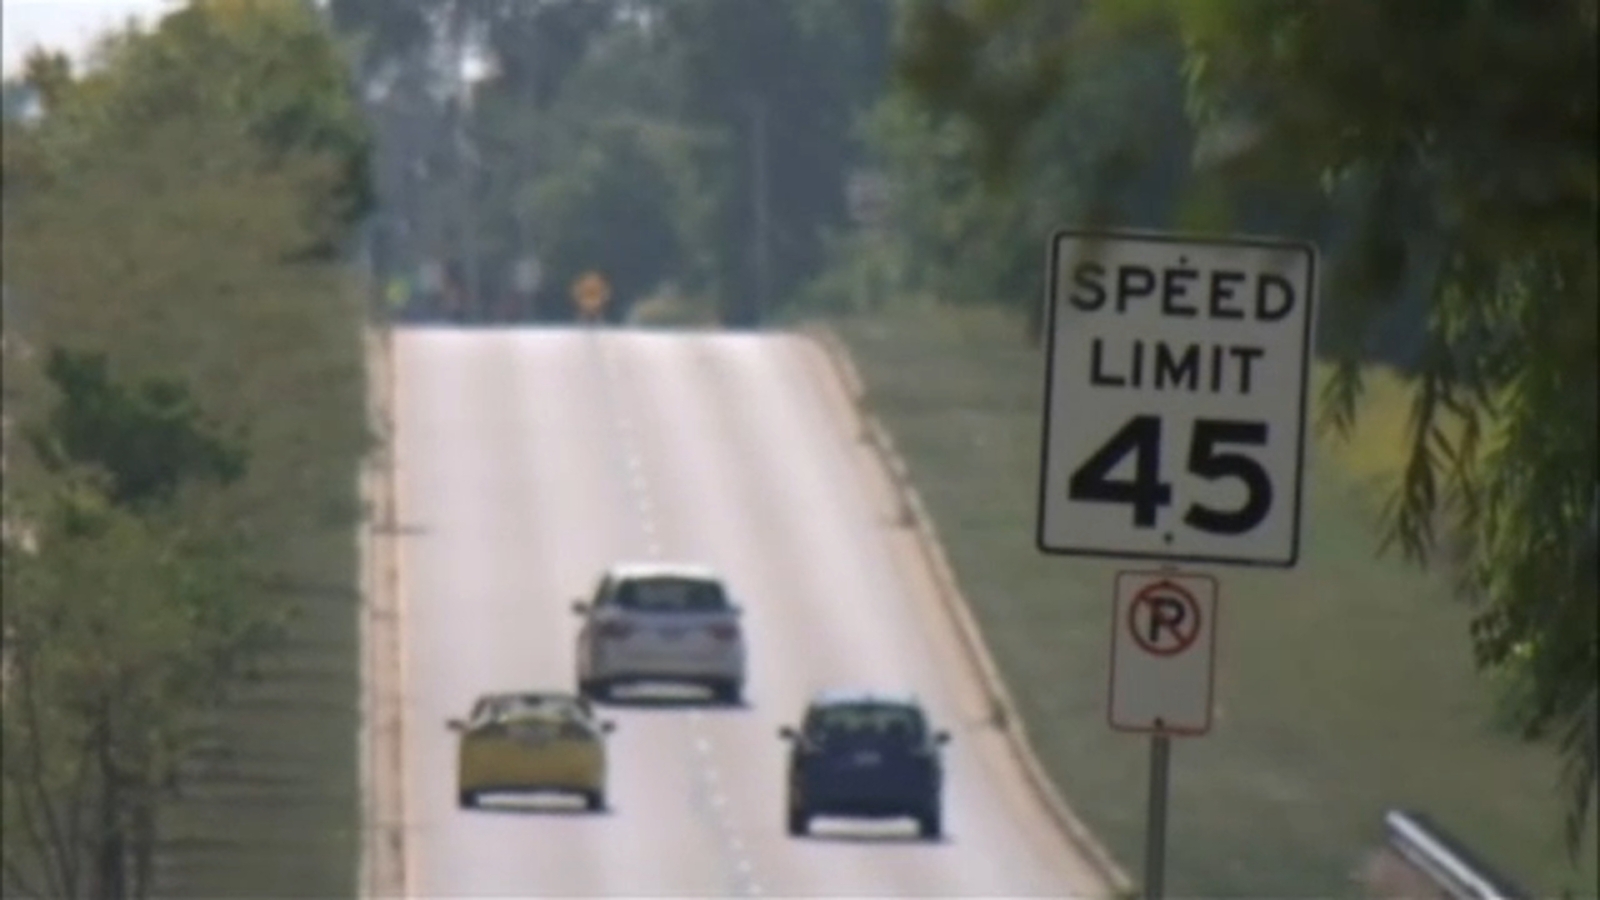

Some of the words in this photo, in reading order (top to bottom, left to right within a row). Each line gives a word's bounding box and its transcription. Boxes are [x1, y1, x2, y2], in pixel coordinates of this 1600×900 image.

[1068, 263, 1296, 322] SPEED
[1089, 337, 1265, 395] LIMIT
[1067, 414, 1274, 536] 45
